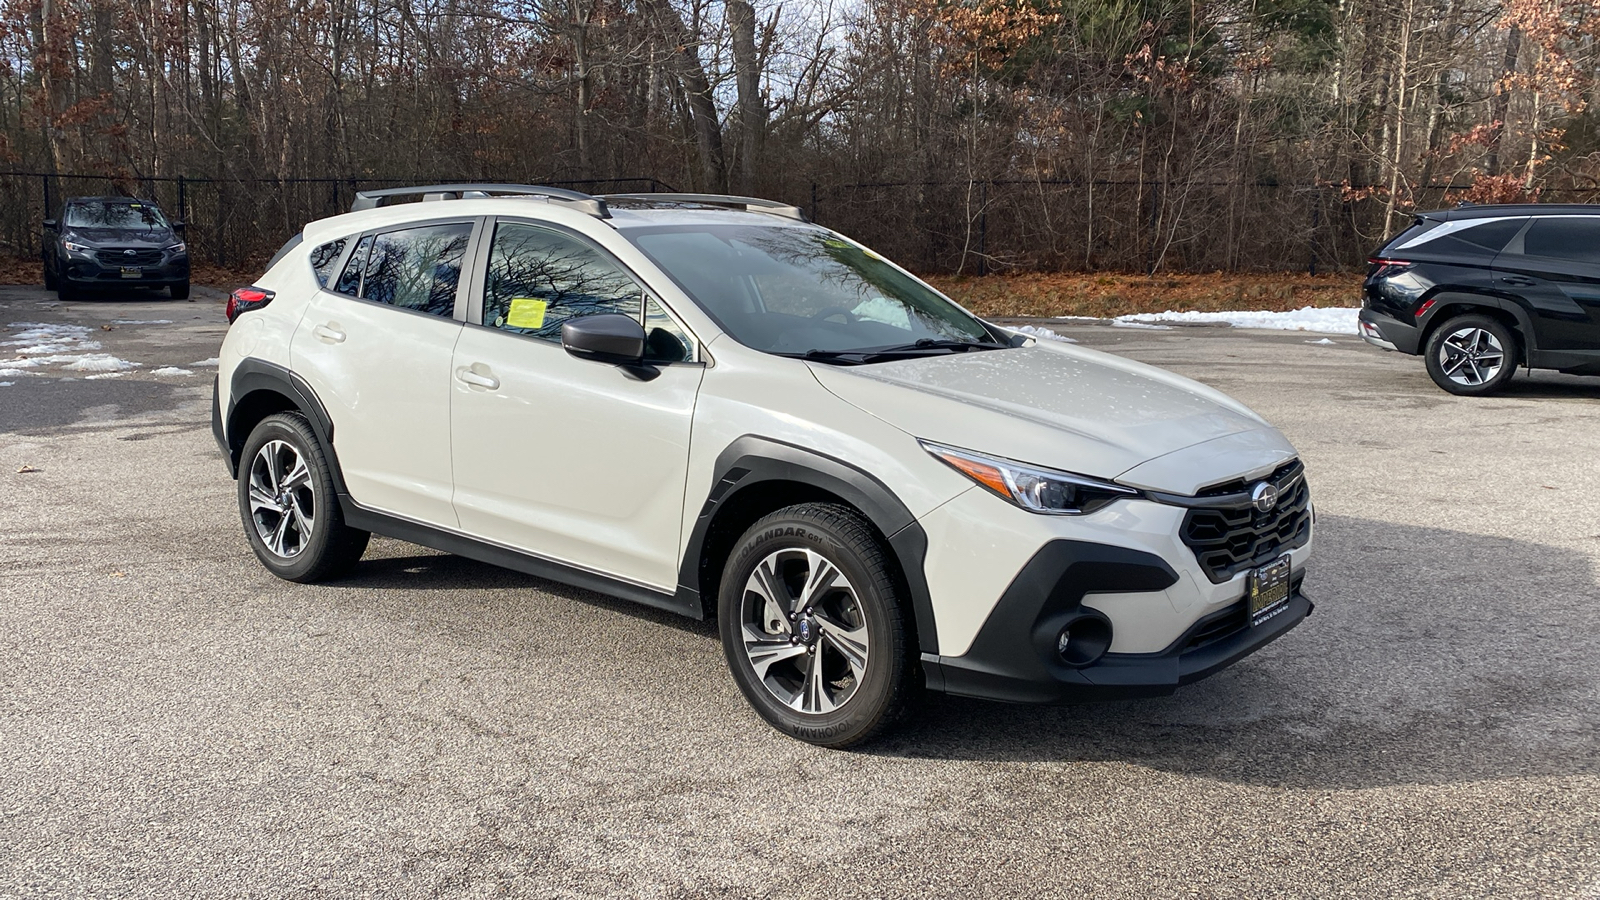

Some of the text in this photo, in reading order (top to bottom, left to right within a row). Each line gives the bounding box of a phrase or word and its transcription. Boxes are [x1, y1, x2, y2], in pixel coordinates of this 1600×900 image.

[808, 533, 823, 544] G91
[1252, 581, 1288, 612] IMPERIAL
[792, 719, 851, 738] YOKOHAMA
